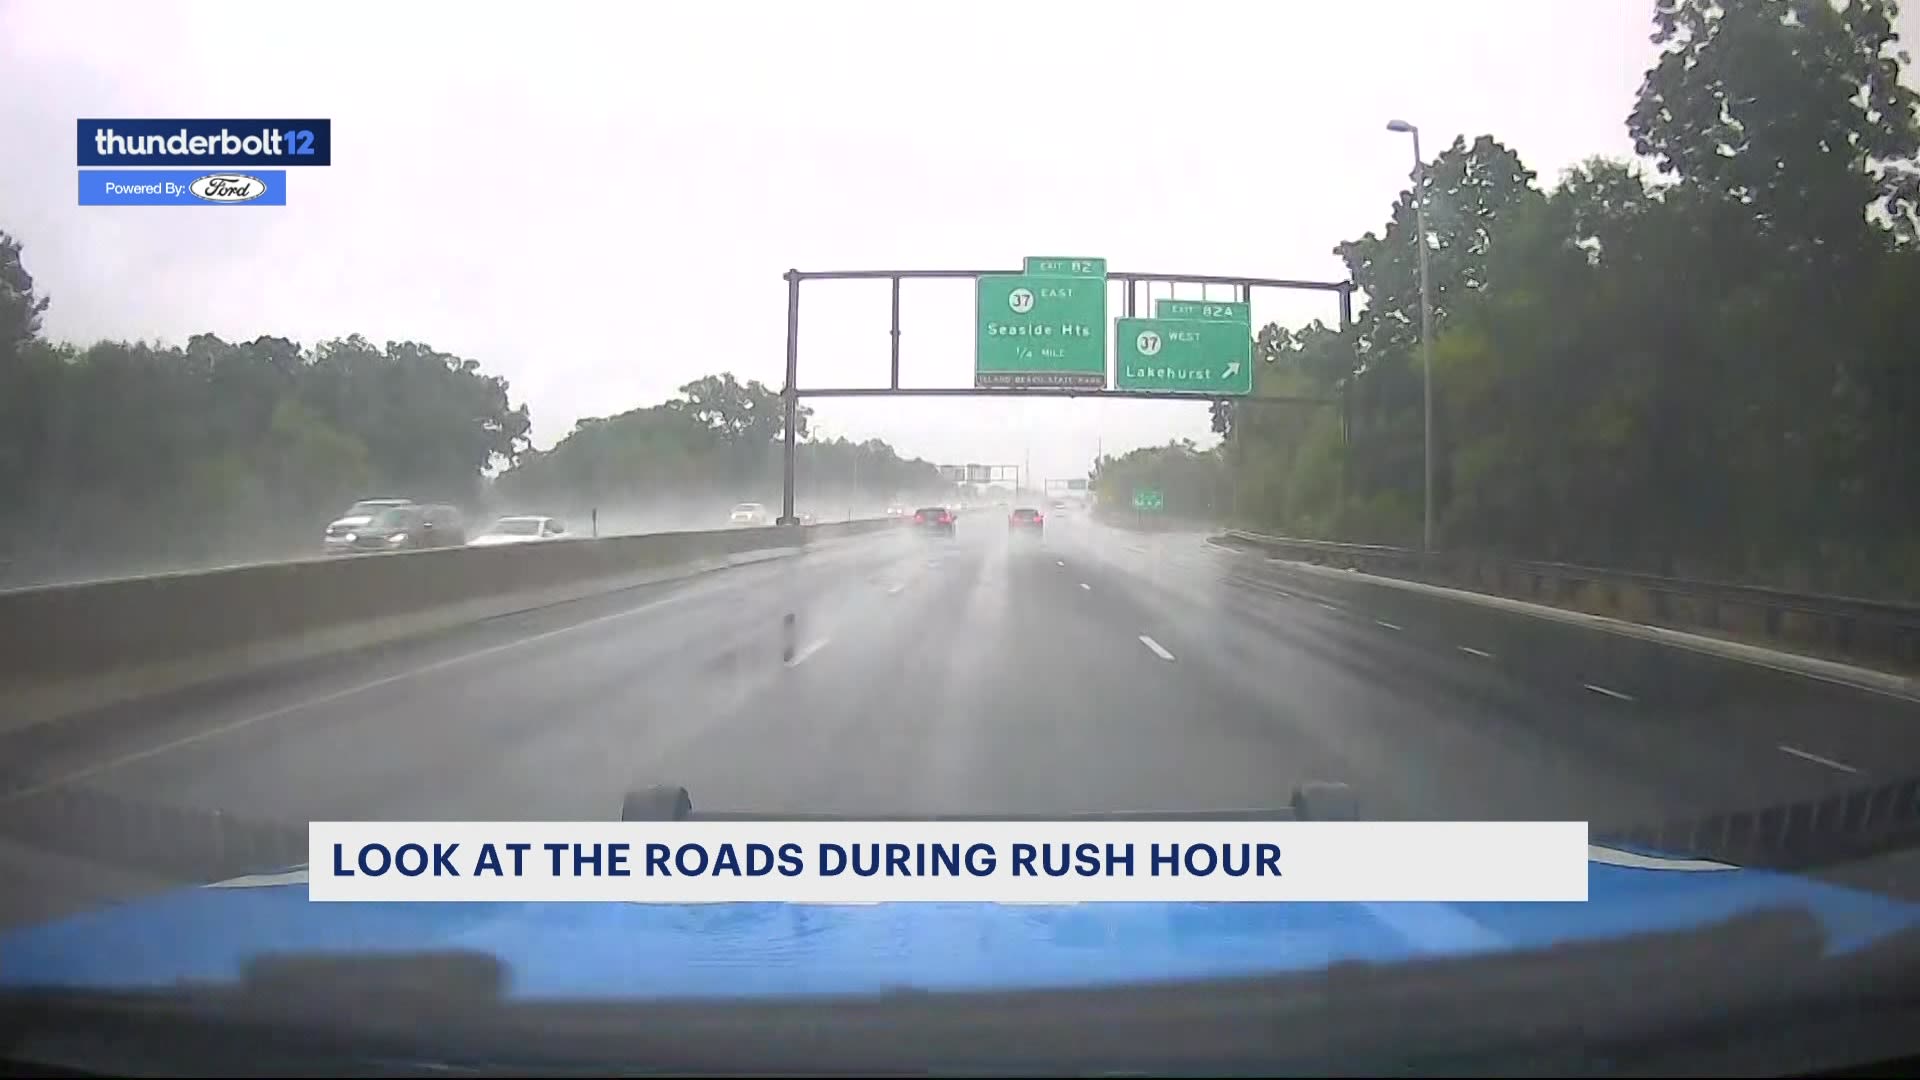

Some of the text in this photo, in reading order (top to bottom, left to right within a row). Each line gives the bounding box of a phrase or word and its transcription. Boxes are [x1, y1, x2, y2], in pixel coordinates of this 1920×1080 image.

[1071, 261, 1093, 273] 82
[1040, 288, 1073, 298] EAST
[1011, 294, 1030, 307] 37
[1202, 304, 1233, 317] 82A
[988, 323, 1091, 337] Seaside Hts
[1168, 331, 1200, 342] WEST
[1140, 336, 1159, 350] 37
[1041, 348, 1065, 358] MILE
[1126, 366, 1211, 380] Lakehurst
